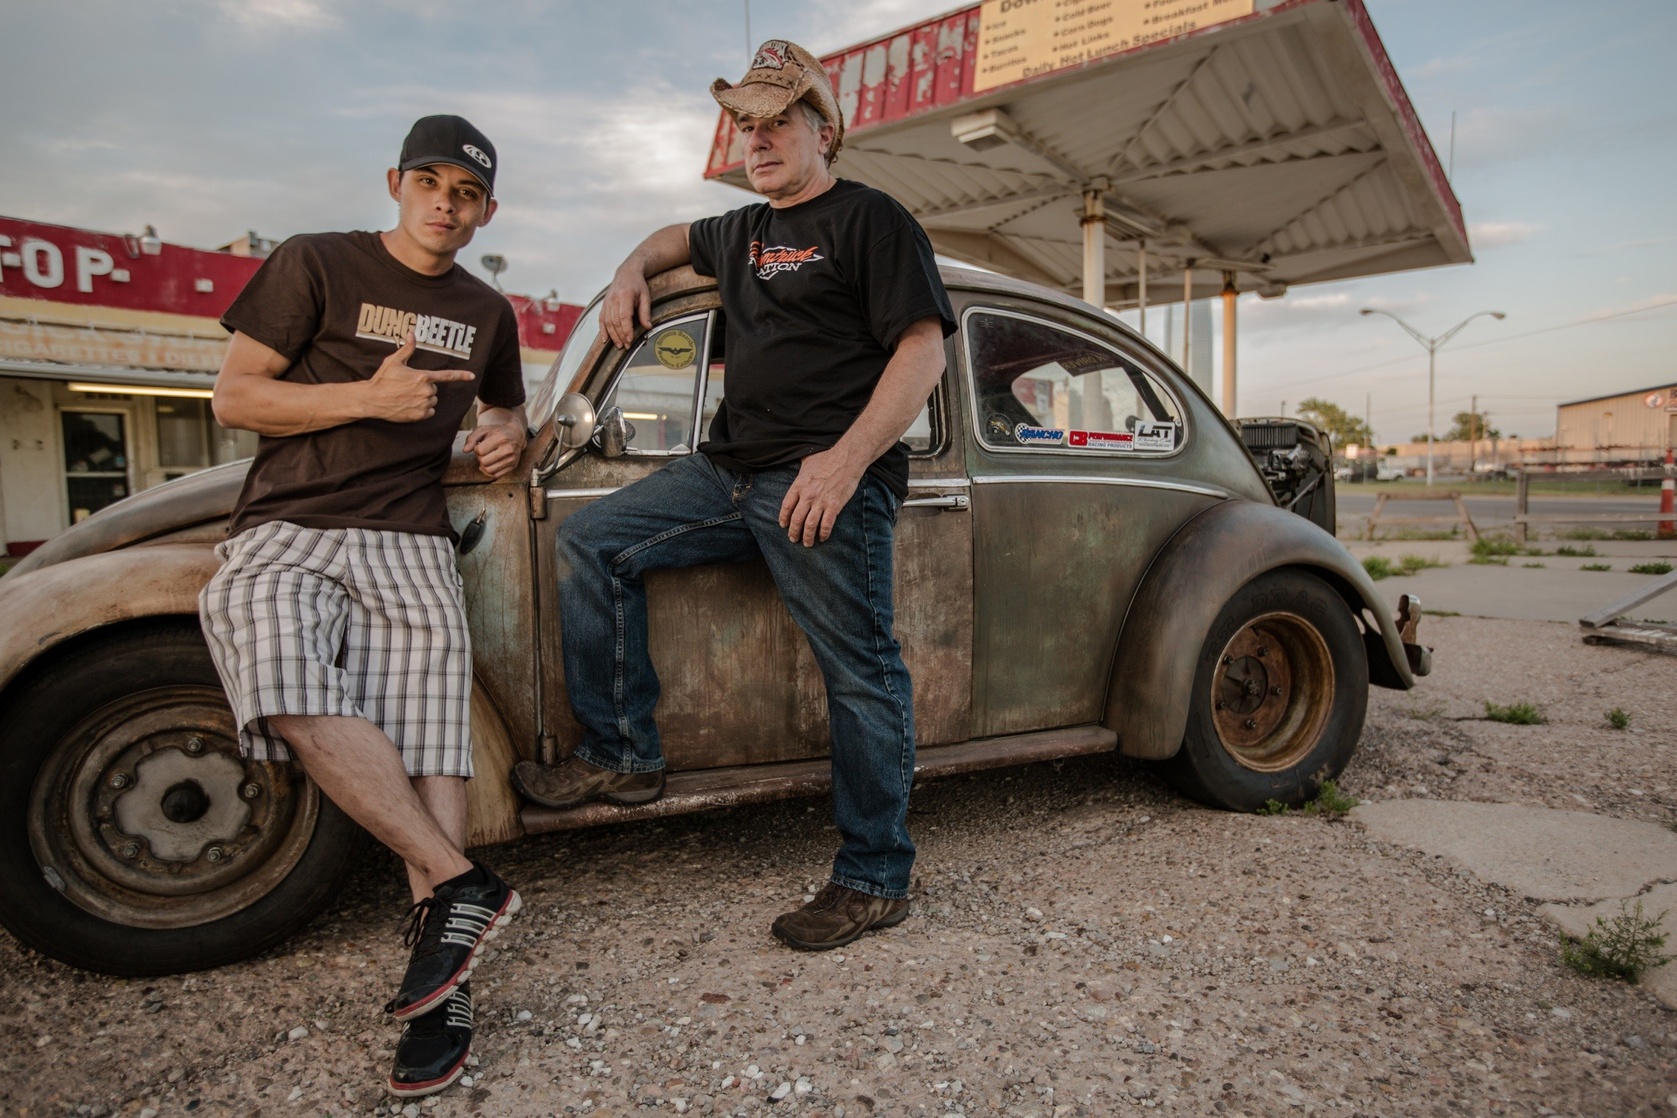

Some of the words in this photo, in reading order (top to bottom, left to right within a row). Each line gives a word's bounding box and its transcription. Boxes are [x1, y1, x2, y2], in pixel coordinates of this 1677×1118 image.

[1062, 9, 1085, 22] Cold
[1087, 1, 1112, 15] Beer
[1151, 2, 1208, 25] Breakfast
[1087, 16, 1114, 29] Dogs
[1022, 61, 1056, 78] Daily
[1060, 51, 1084, 68] Hot
[1086, 39, 1129, 61] Lunch
[1132, 21, 1197, 47] Specials
[1060, 41, 1079, 52] Hot
[1081, 32, 1110, 46] Links
[1021, 428, 1064, 440] RANCHO
[1137, 424, 1173, 438] LAT
